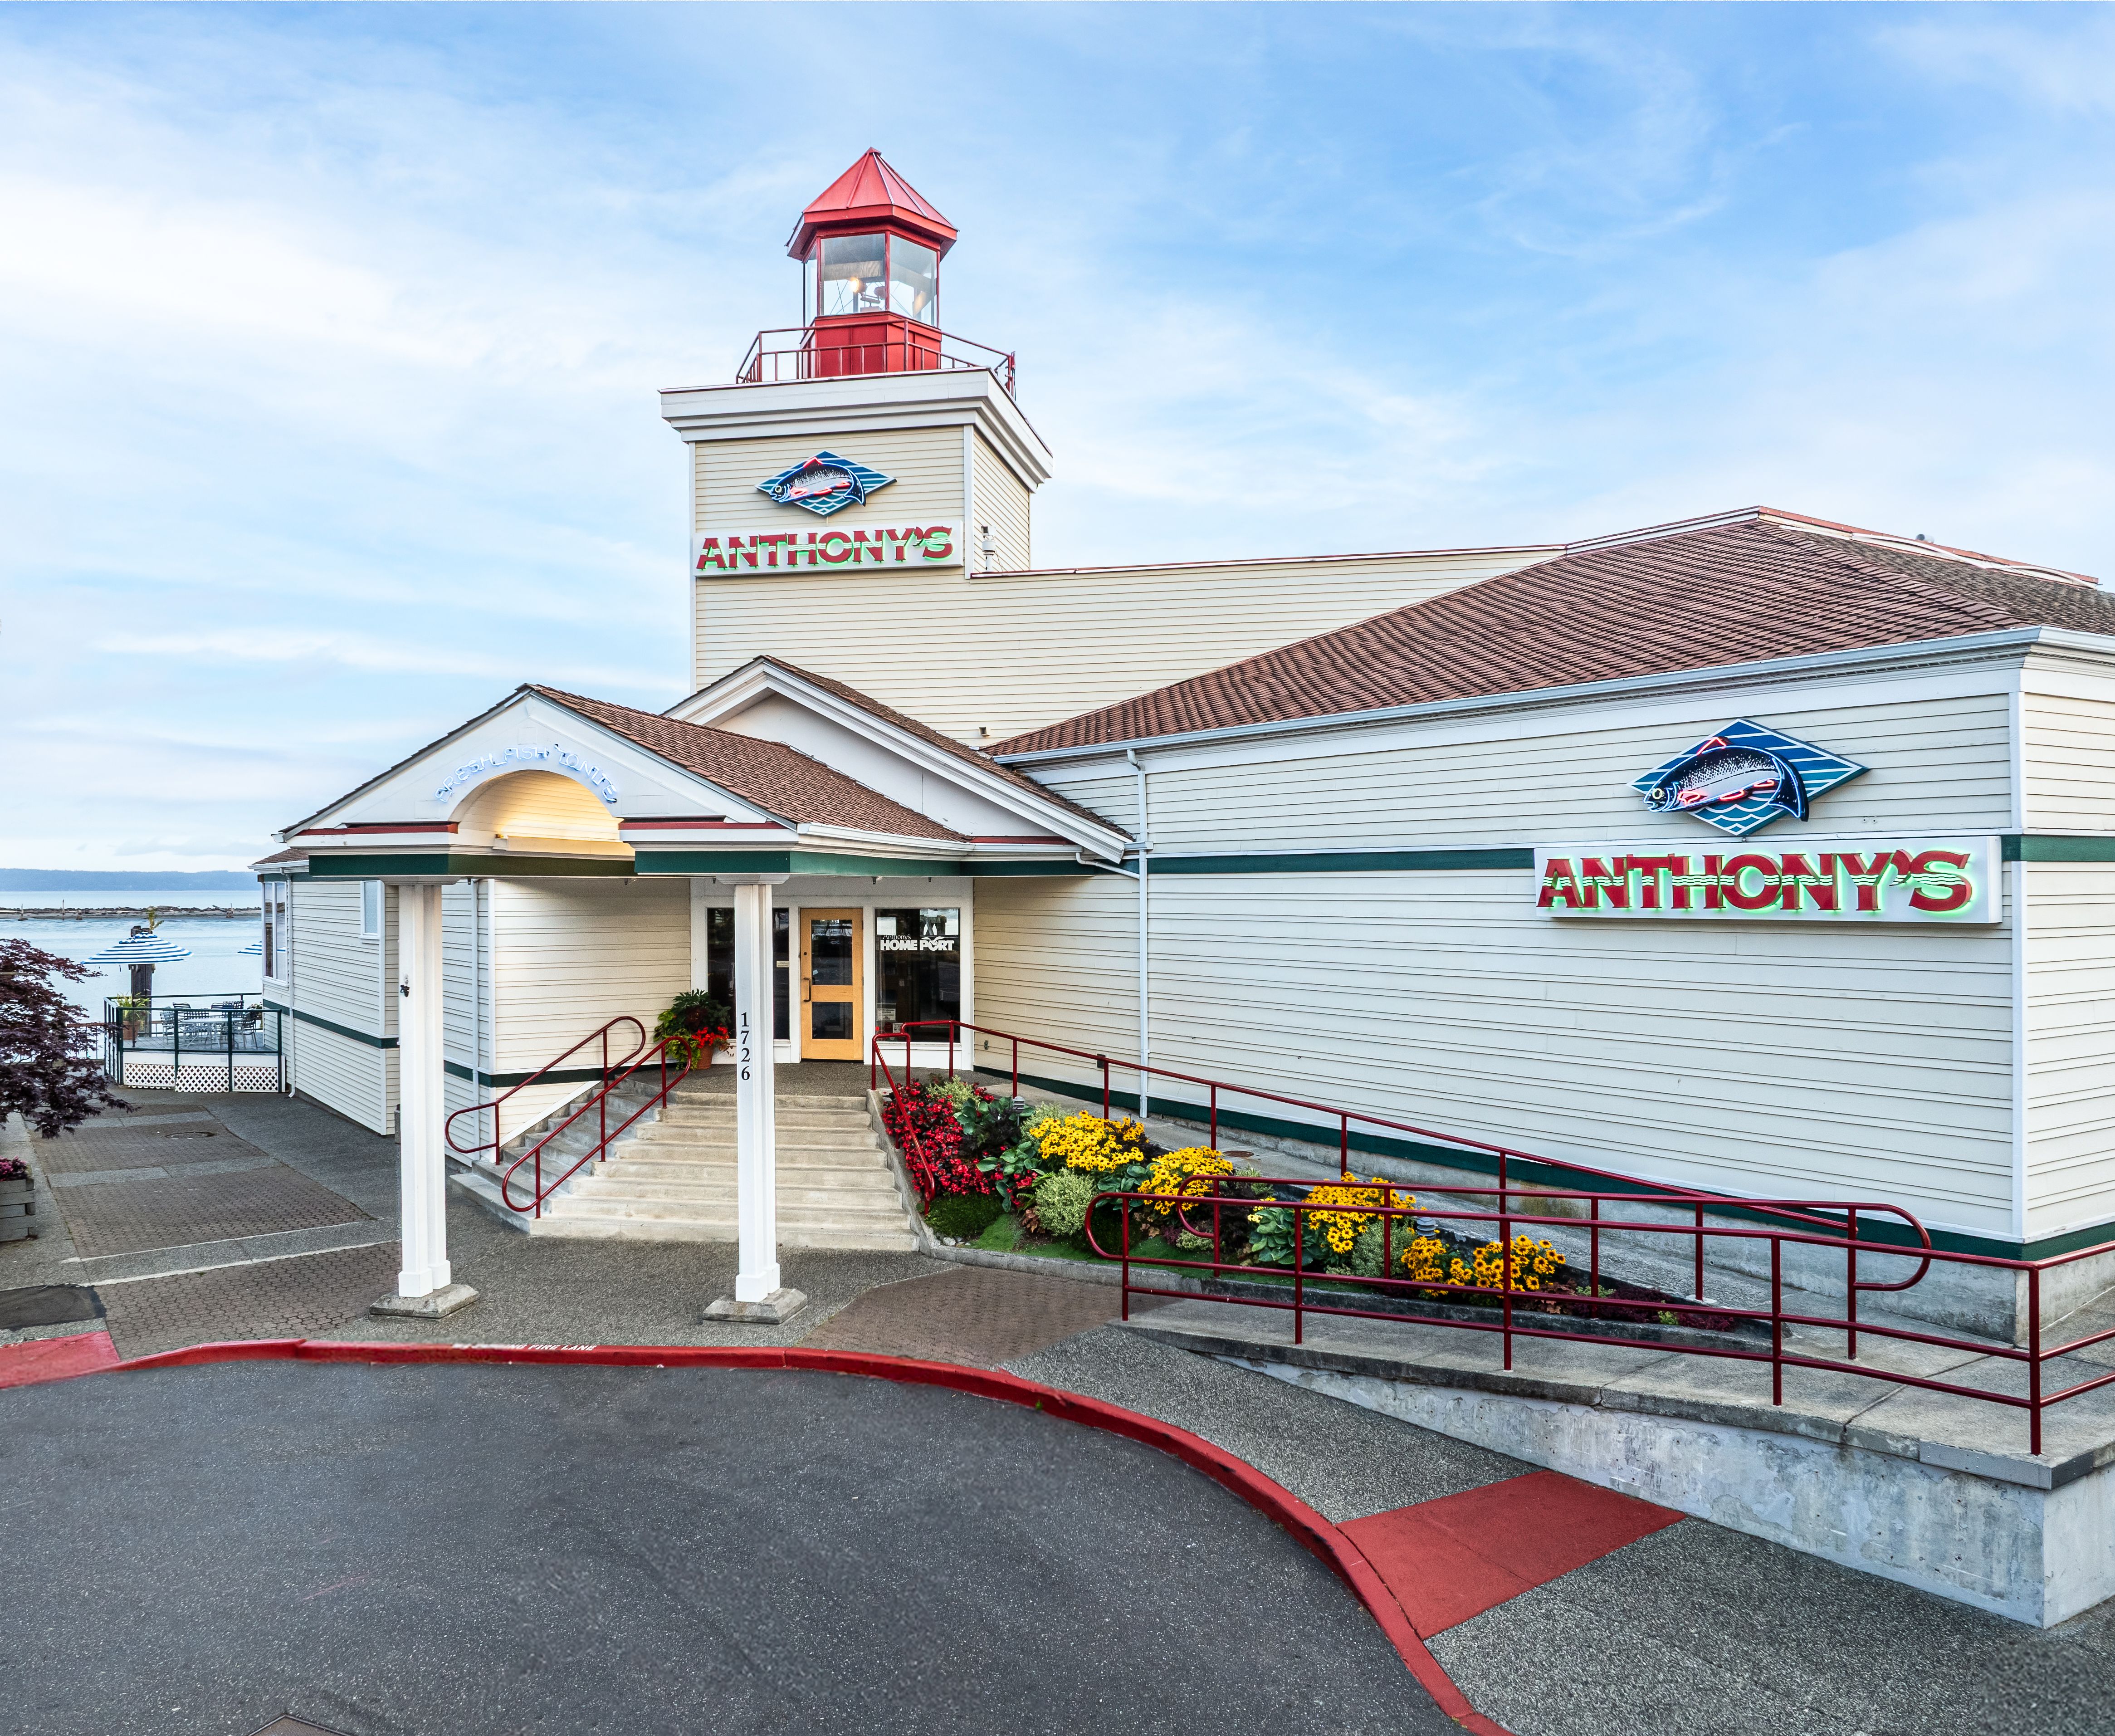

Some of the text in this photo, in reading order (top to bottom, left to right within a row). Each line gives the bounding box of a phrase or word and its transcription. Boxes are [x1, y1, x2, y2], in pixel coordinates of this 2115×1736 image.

[696, 525, 953, 570] ANTHONY'S
[435, 744, 617, 802] FRESH FISH TONITE
[1535, 848, 1973, 913] ANTHONY'S
[880, 939, 954, 951] HOME PORT
[740, 1012, 751, 1081] 1726
